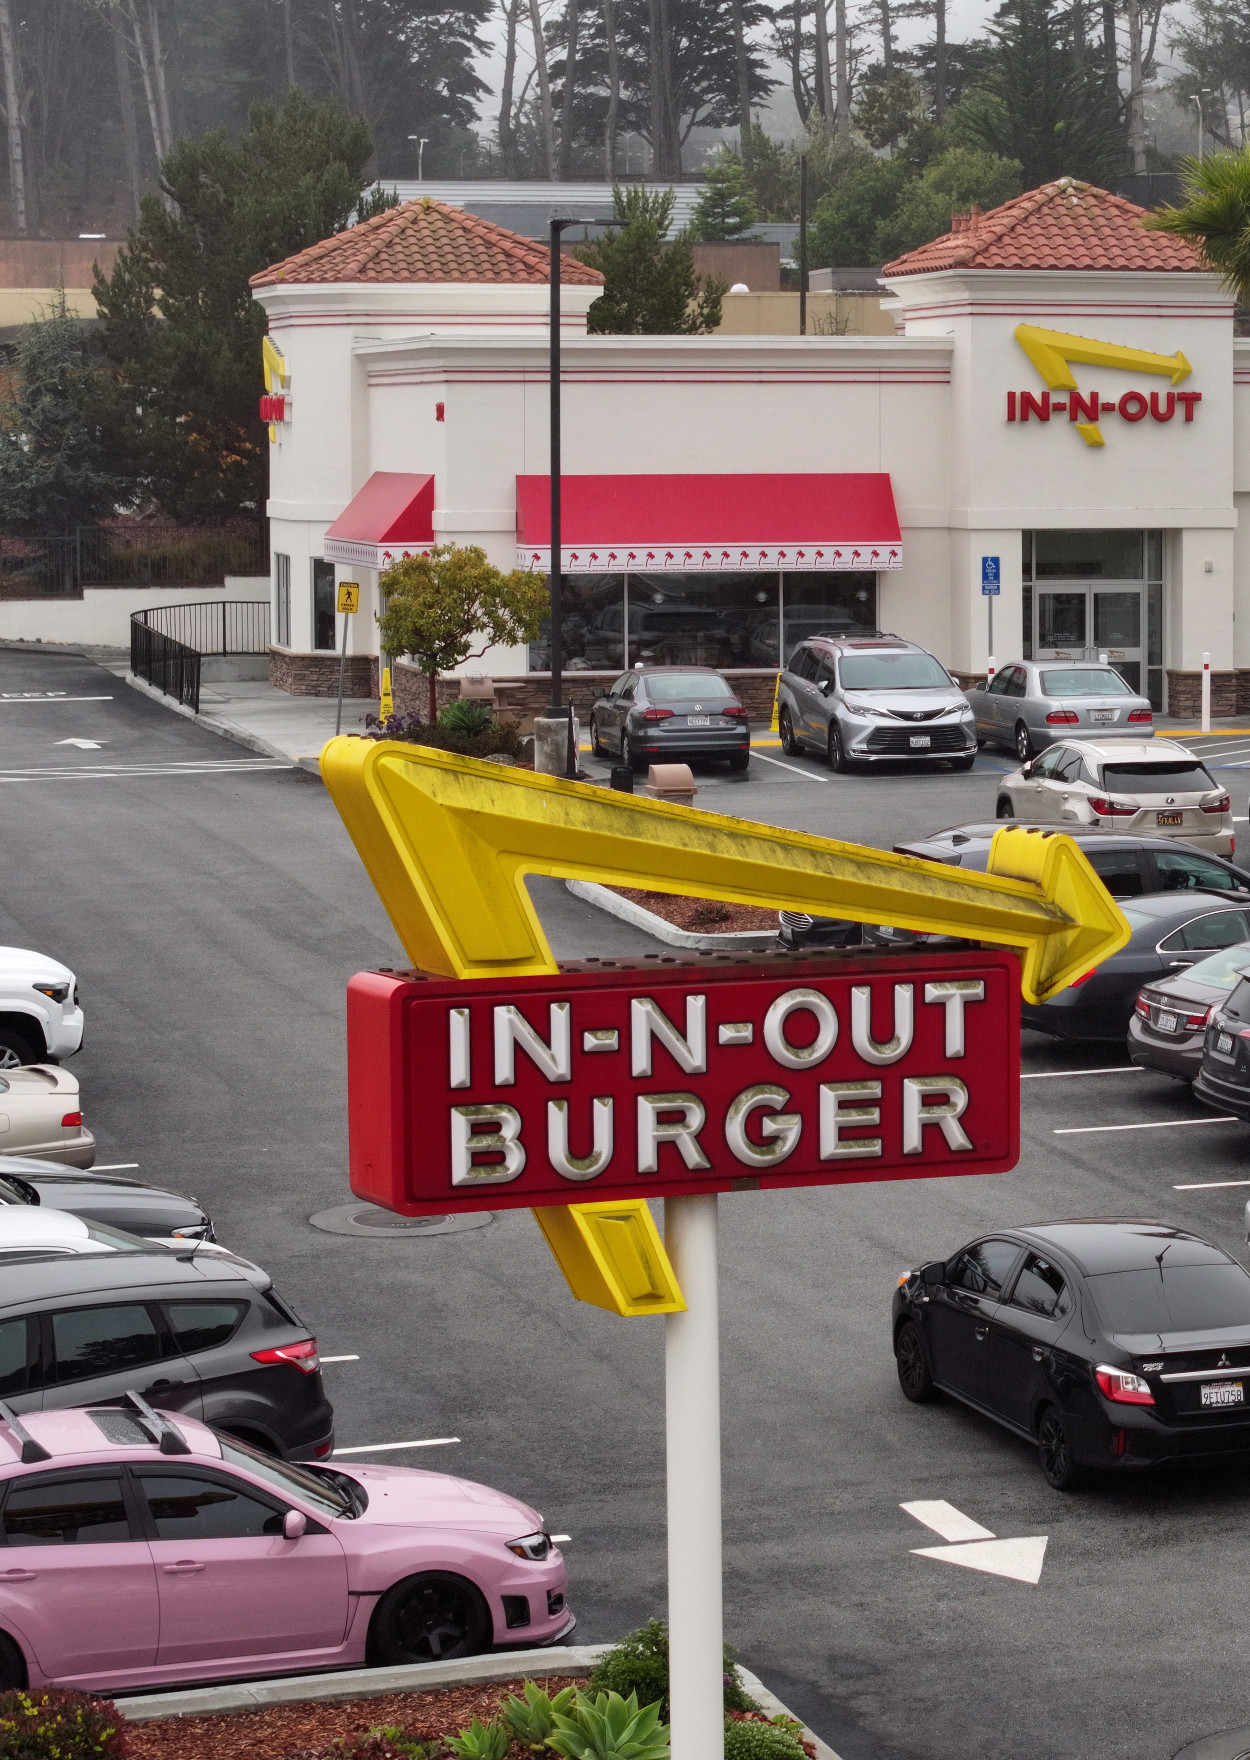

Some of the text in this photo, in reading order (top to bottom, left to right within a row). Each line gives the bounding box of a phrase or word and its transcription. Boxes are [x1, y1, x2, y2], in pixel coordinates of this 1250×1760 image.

[1007, 391, 1202, 422] IN-N-OUT
[449, 980, 986, 1089] IN-N-OUT
[450, 1075, 974, 1186] BURGER
[1203, 1390, 1243, 1405] 9EIU758
